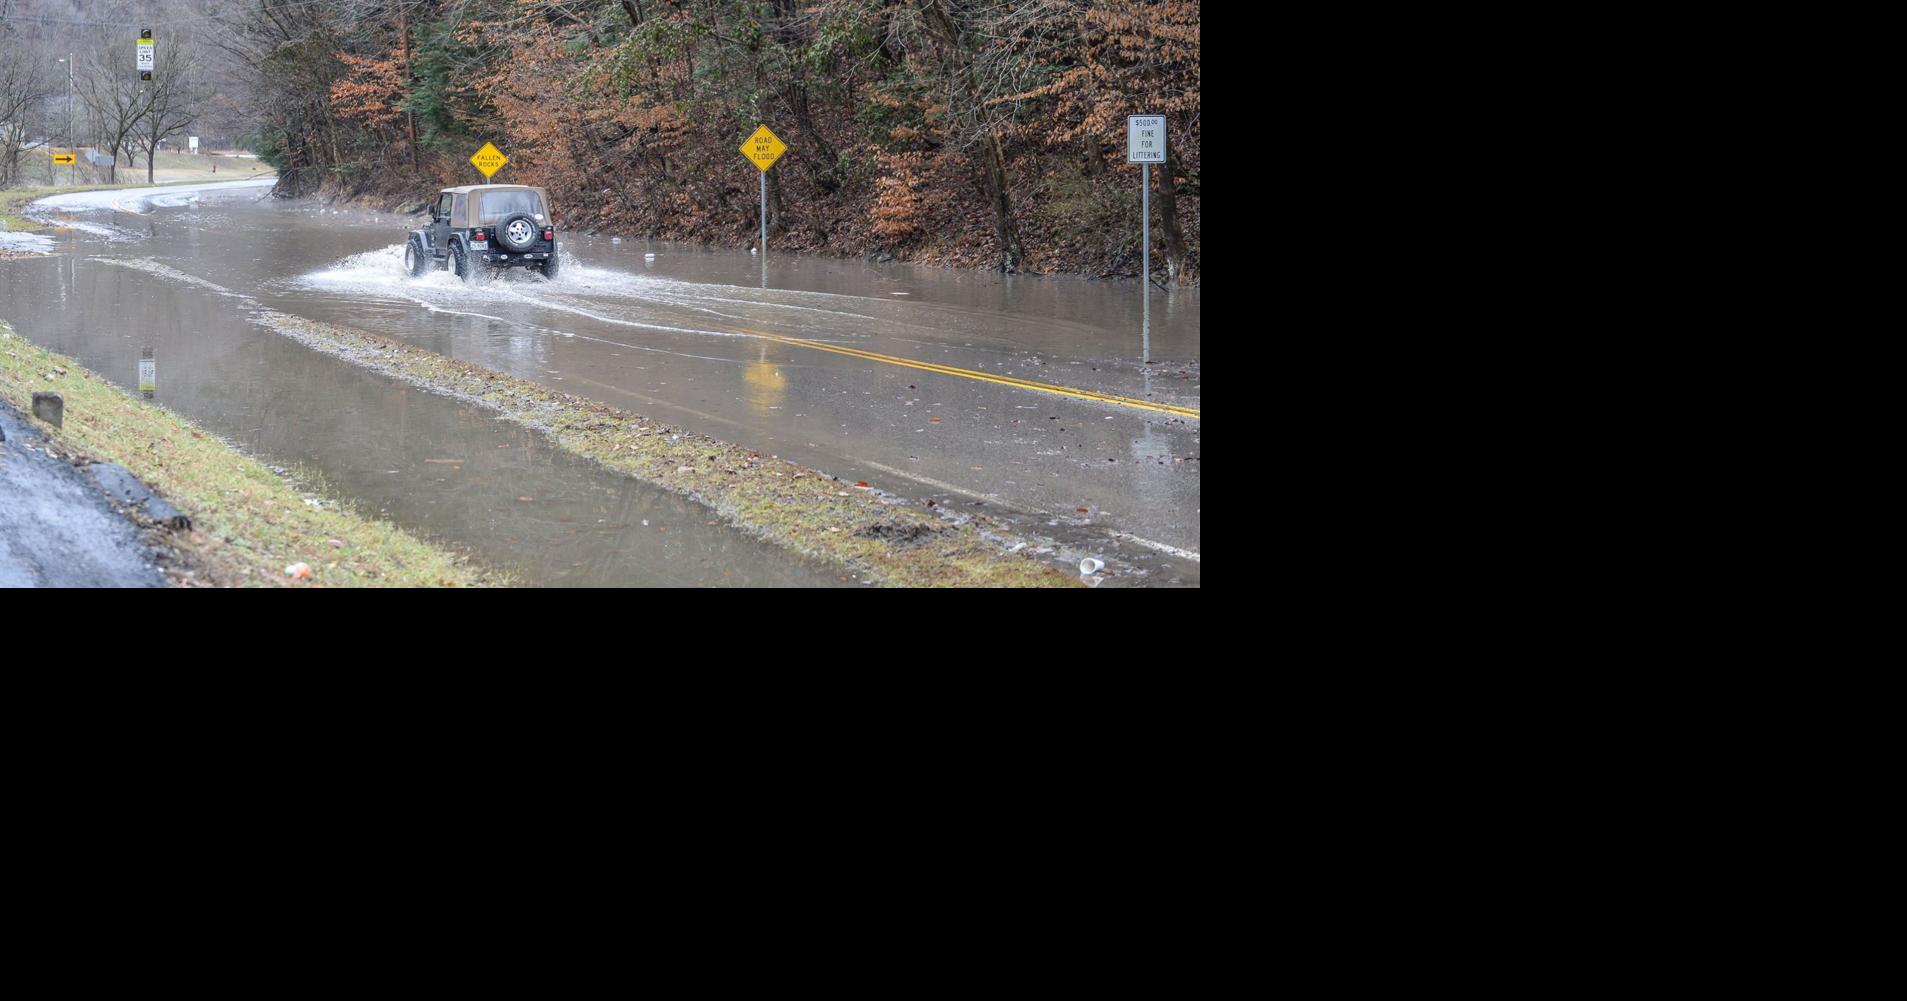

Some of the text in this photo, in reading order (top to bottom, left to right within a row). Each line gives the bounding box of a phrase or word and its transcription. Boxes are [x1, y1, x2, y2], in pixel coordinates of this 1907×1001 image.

[139, 54, 152, 62] 35
[1141, 129, 1155, 138] FINE
[1141, 140, 1153, 149] FOR
[753, 152, 775, 161] FLOOD
[1132, 151, 1161, 160] LITTERING
